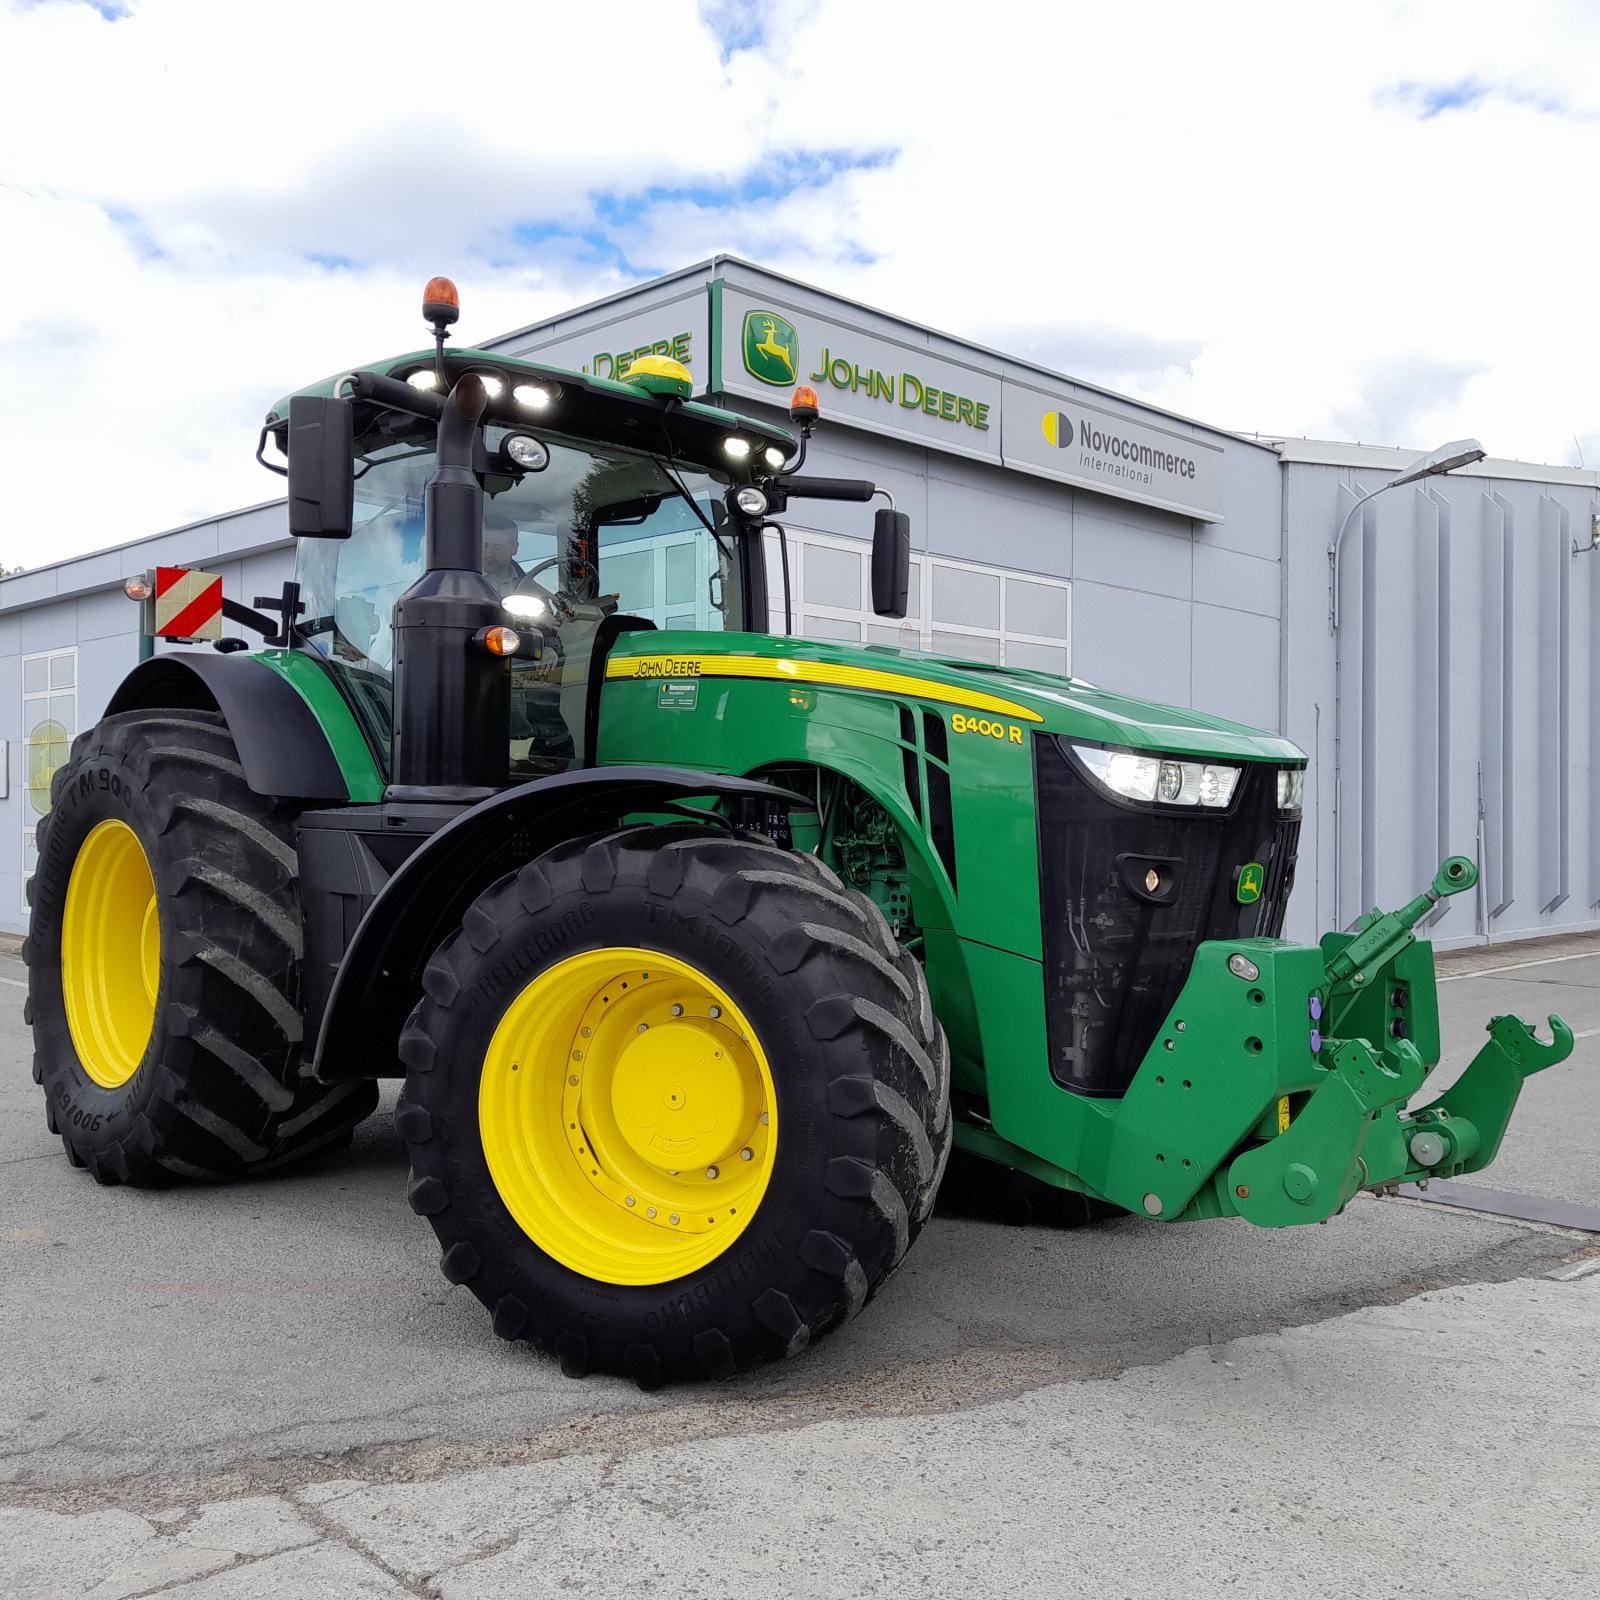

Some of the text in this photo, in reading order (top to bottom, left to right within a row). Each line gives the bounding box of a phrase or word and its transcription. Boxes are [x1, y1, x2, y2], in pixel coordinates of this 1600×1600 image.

[809, 347, 990, 430] JOHN DEERE
[1079, 452, 1153, 485] International
[1080, 419, 1196, 479] Novocommerce
[634, 658, 702, 675] JOHN DEERE
[951, 713, 1023, 745] 8400 R
[471, 901, 594, 1007] TRELLEBORG
